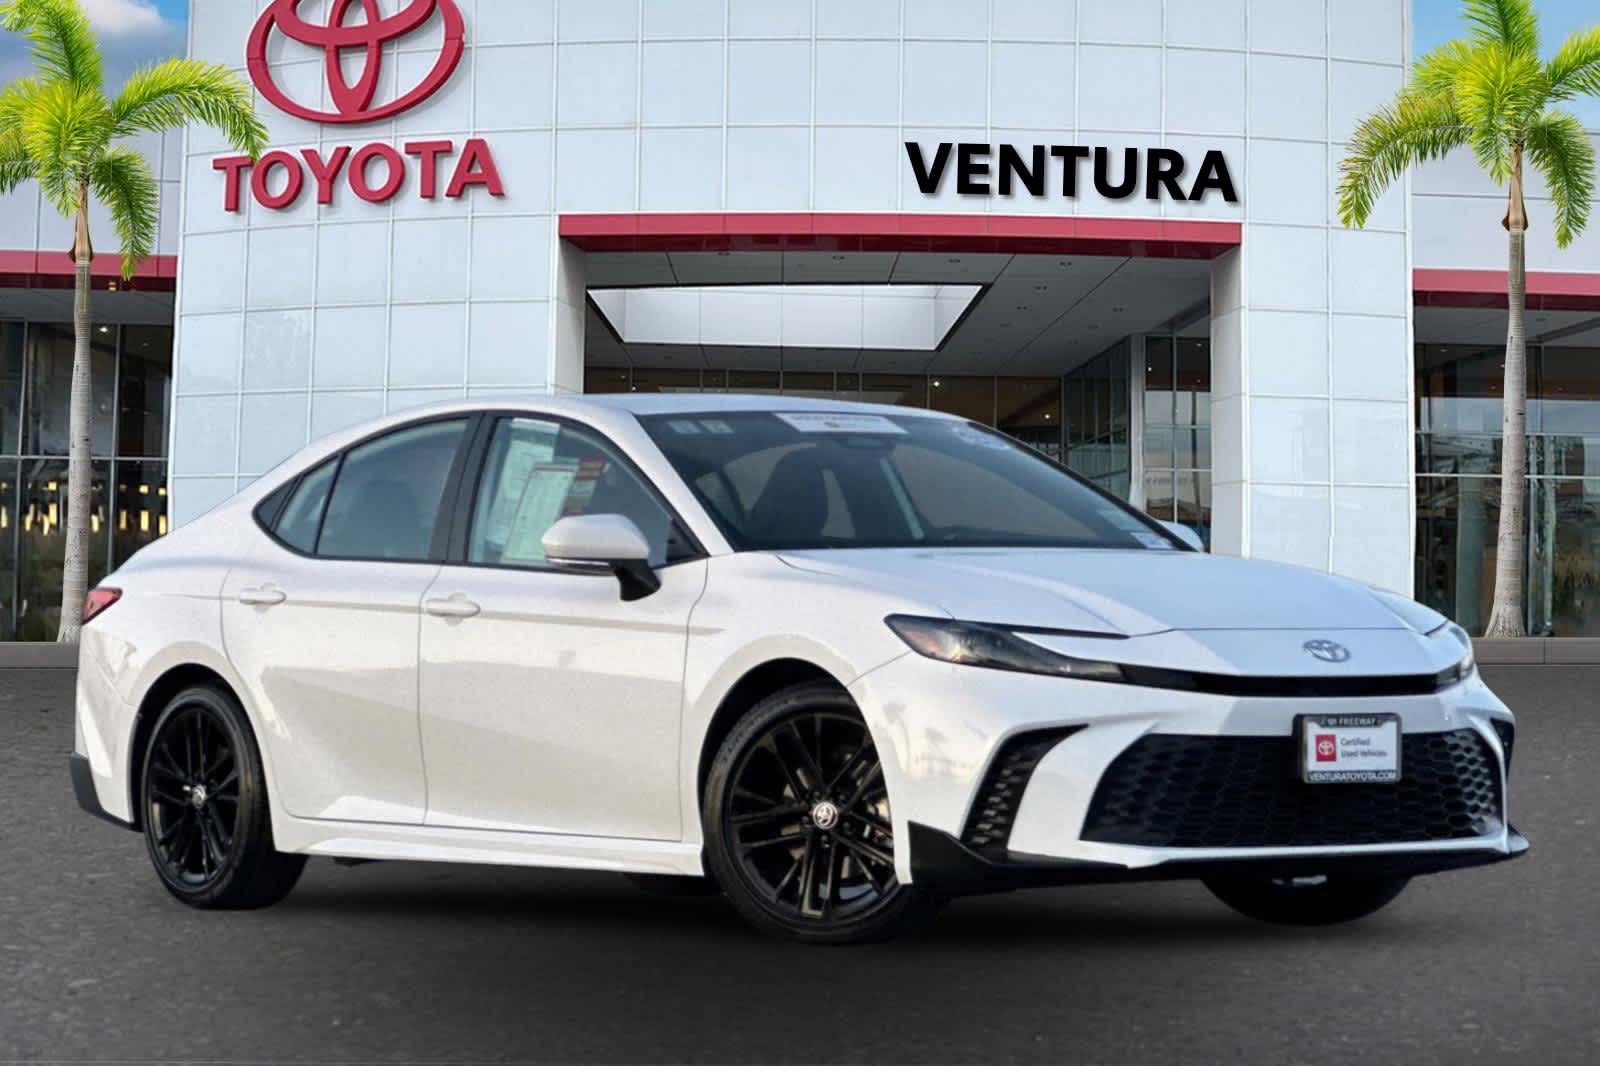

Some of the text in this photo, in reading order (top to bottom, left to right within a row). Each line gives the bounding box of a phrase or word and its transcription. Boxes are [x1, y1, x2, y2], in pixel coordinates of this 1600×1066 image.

[213, 137, 505, 212] TOYOTA
[905, 141, 1238, 203] VENTURA
[1339, 717, 1376, 726] FREEWAY
[1340, 736, 1371, 747] Certified
[1341, 748, 1387, 758] Used Vehicles
[1309, 771, 1397, 782] VENTURATOYOTA.COM
